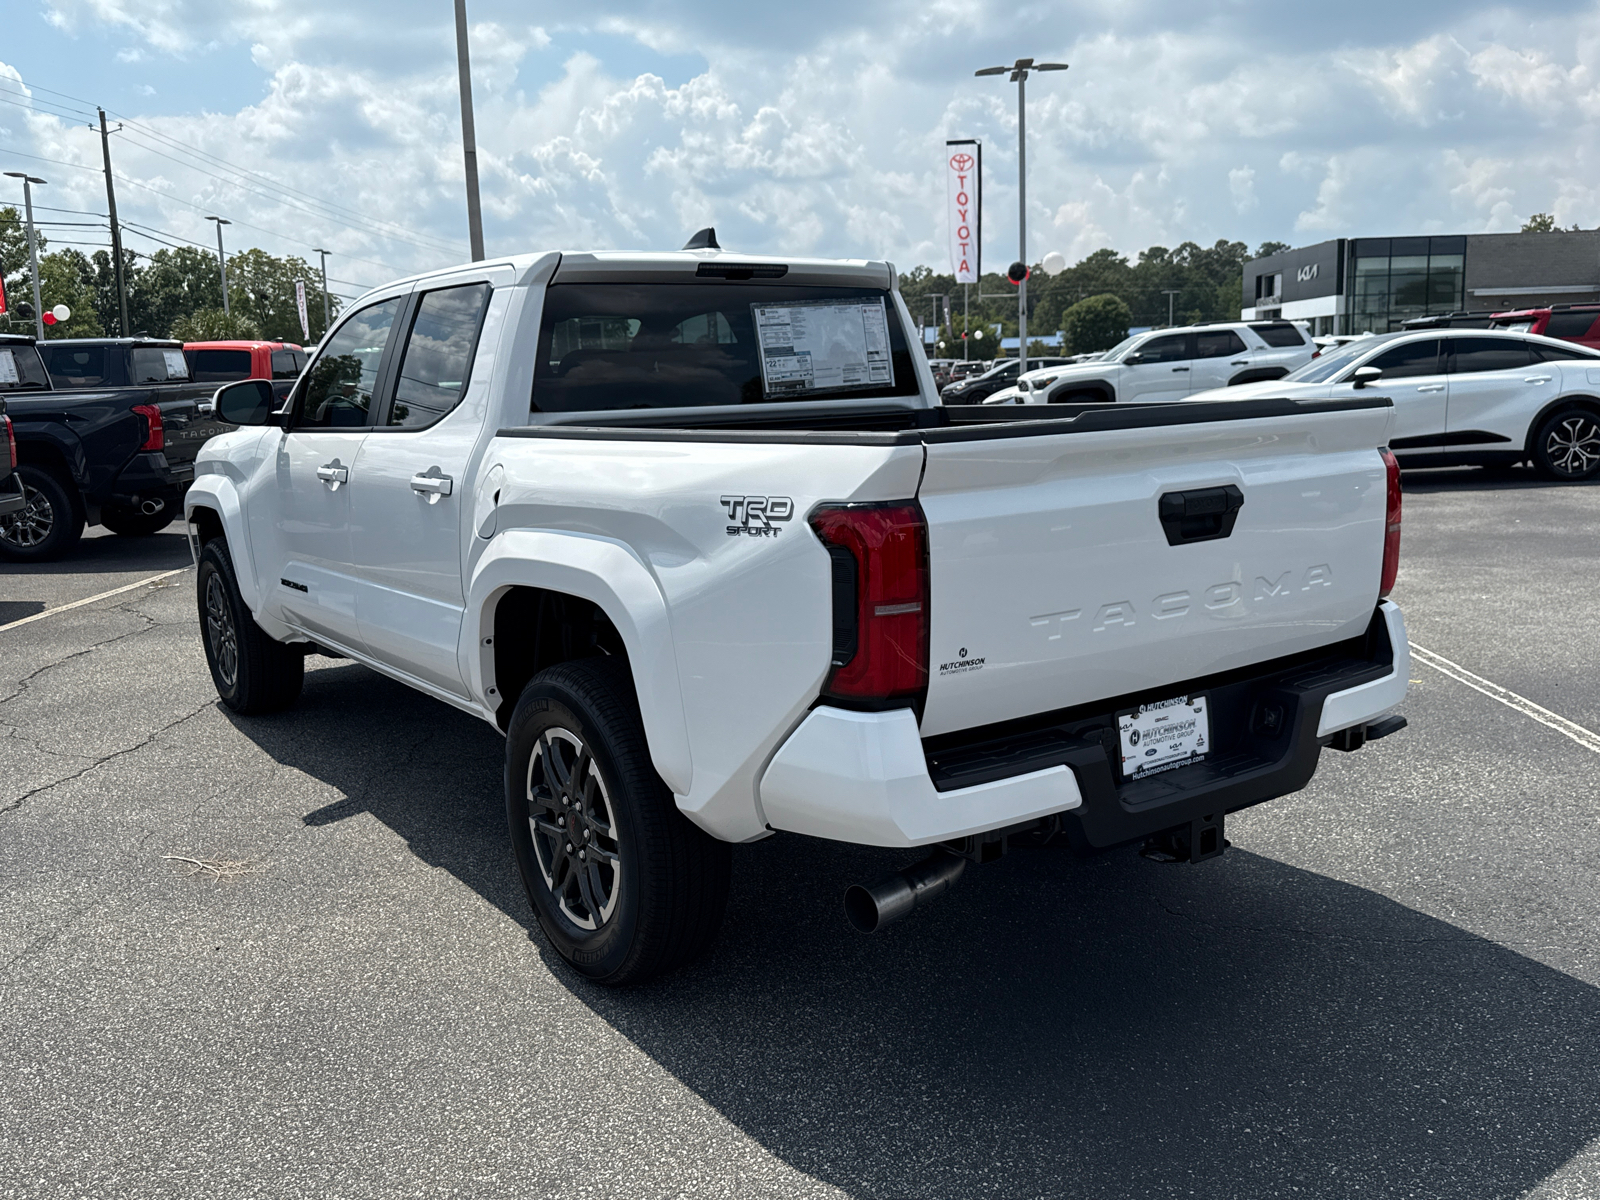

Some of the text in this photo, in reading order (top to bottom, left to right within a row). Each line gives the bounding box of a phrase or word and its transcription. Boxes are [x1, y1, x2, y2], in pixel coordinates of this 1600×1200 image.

[957, 175, 970, 273] TOYOTA
[1297, 263, 1318, 282] KIA
[180, 426, 231, 439] TACOMA
[720, 495, 795, 528] TRD
[725, 526, 782, 537] SPORT
[1029, 563, 1333, 640] TACOMA
[939, 657, 986, 671] HUTCHINSON
[940, 667, 967, 676] AUTOMOTIVE
[517, 699, 549, 727] MICHELIN
[1147, 695, 1188, 712] HUTCHINSON
[1142, 719, 1196, 740] HUTCHINSON
[1143, 730, 1194, 747] AUTOMOTIVE GROUP
[1132, 755, 1205, 780] Hutchinsonautogroup.com
[1141, 751, 1187, 766] UTCHINSONAUTOGROUP.COM
[573, 944, 610, 964] MICHELIN
